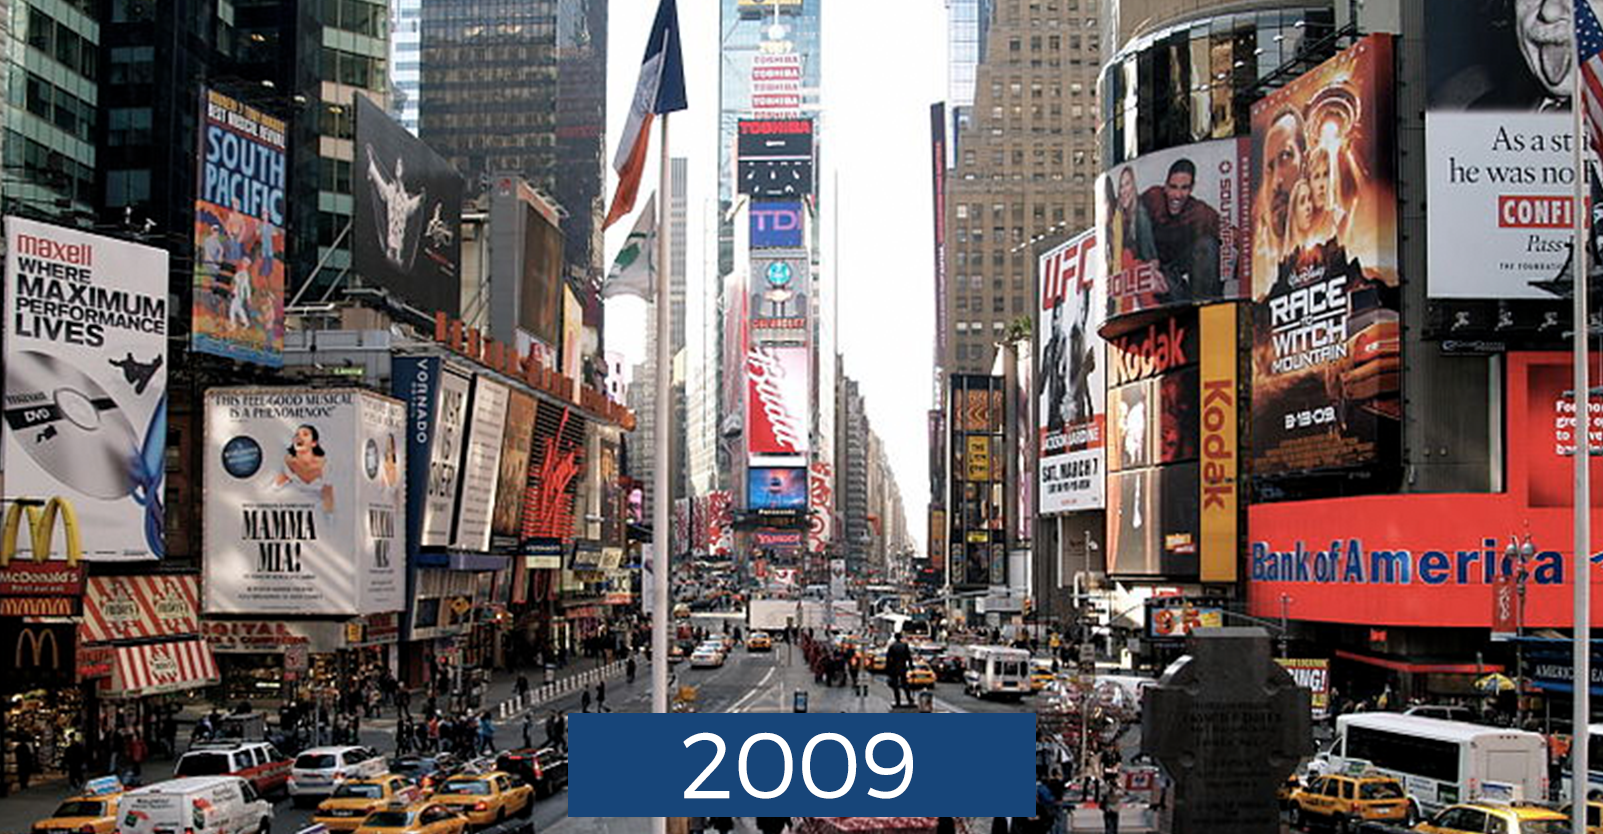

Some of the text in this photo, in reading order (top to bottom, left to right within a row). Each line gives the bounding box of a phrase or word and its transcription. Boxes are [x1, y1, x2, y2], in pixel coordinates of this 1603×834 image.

[1492, 126, 1525, 152] As
[1530, 135, 1545, 152] a
[206, 125, 286, 191] SOUTH
[1450, 157, 1480, 184] he
[1487, 165, 1536, 184] was
[1542, 166, 1575, 184] no
[204, 161, 286, 224] PACIFIC
[750, 210, 805, 230] TD
[1503, 200, 1584, 224] CONFI
[17, 234, 92, 267] maxell
[18, 256, 92, 285] WHERE
[1042, 235, 1097, 311] UFC
[16, 273, 166, 319] MAXIMUM
[1269, 275, 1347, 326] RACE
[15, 314, 105, 348] LIVES
[16, 297, 166, 336] PERFORMANCE
[1112, 317, 1187, 384] Kodak
[1272, 315, 1348, 358] WITCH
[1271, 343, 1348, 375] MOUNTAIN
[24, 408, 51, 423] DVD
[416, 358, 429, 444] VORNADO
[1203, 379, 1234, 511] Kodak
[242, 510, 316, 540] MAMMA
[257, 542, 301, 572] MIA!
[1252, 540, 1311, 583] Bank
[1314, 540, 1343, 583] of
